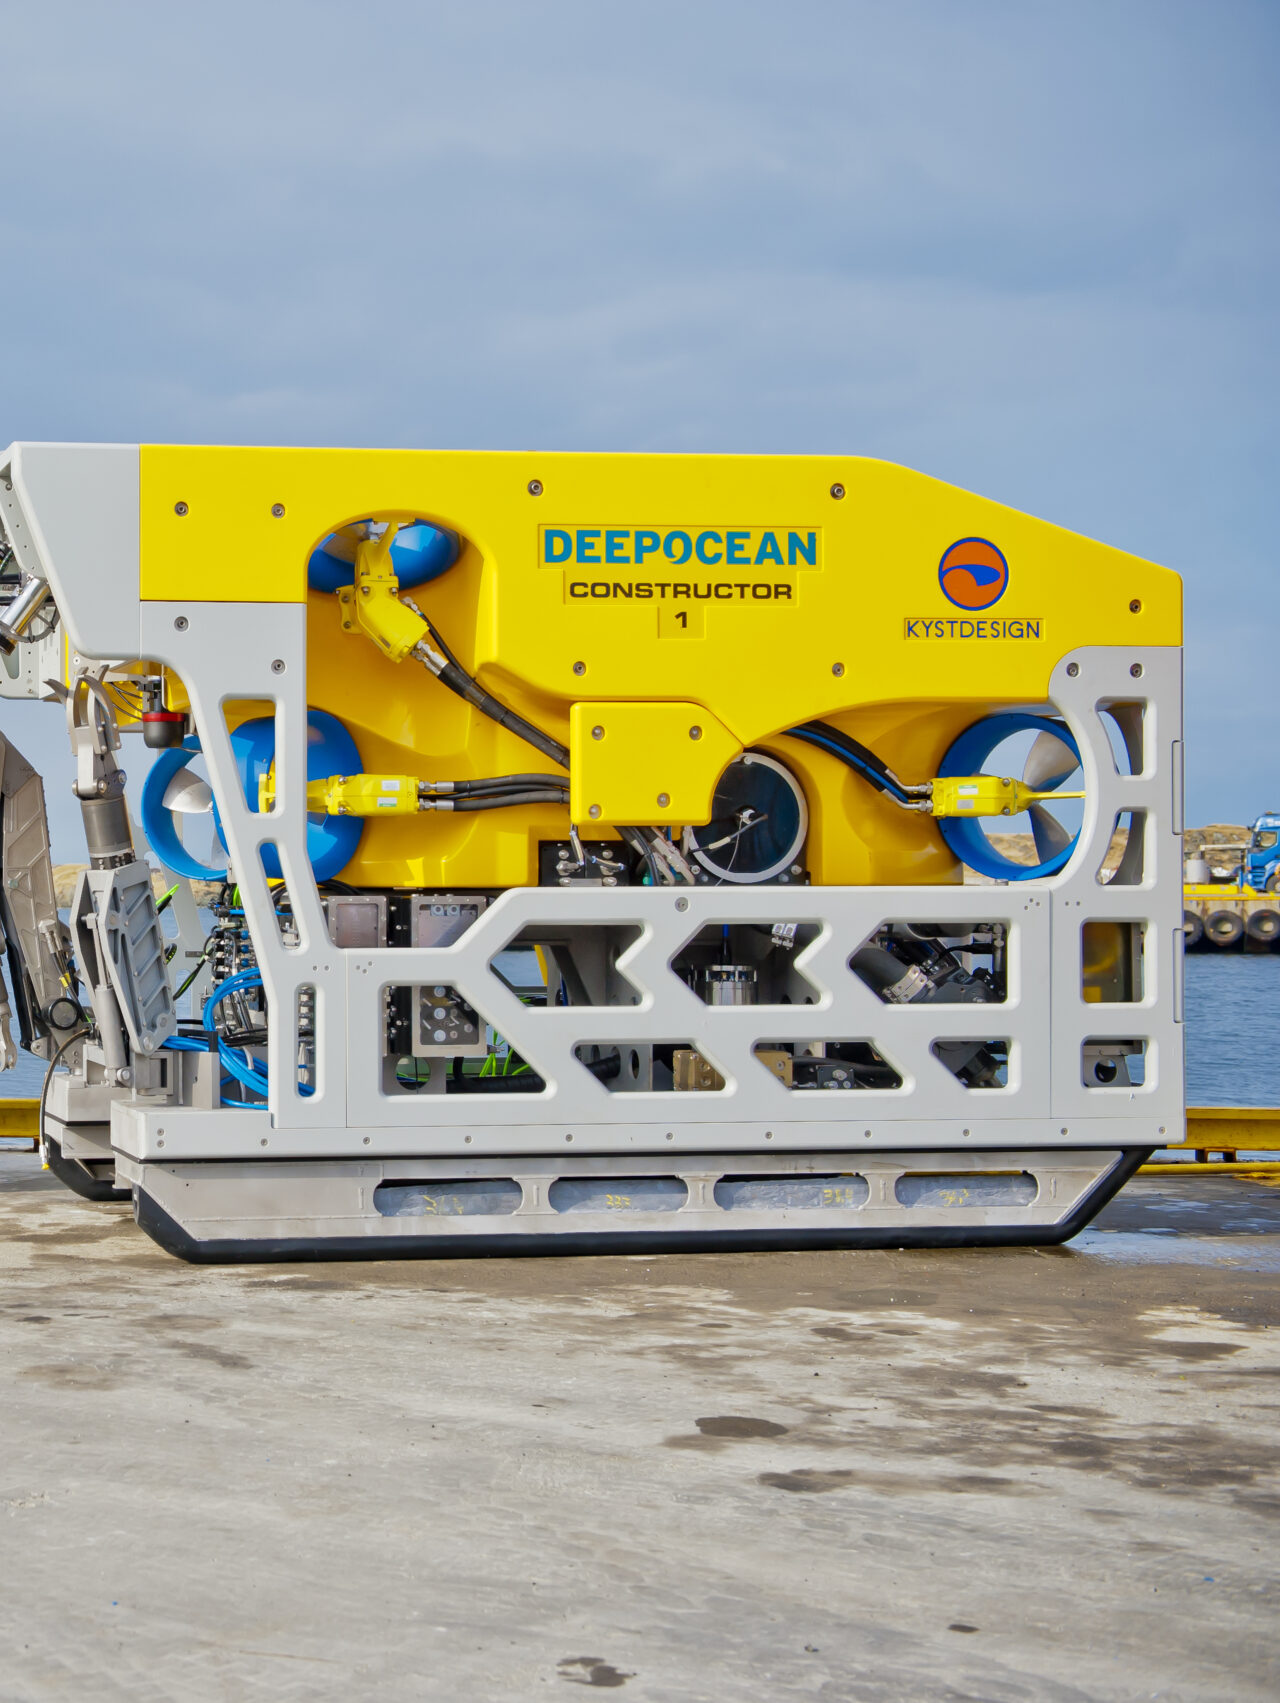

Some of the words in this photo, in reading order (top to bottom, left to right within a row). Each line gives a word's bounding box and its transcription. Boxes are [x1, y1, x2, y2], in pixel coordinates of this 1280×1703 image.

[543, 529, 817, 566] DEEPOCEAN
[569, 582, 792, 600] CONSTRUCTOR
[674, 611, 687, 629] 1
[907, 620, 1040, 639] KYSTDESIGN
